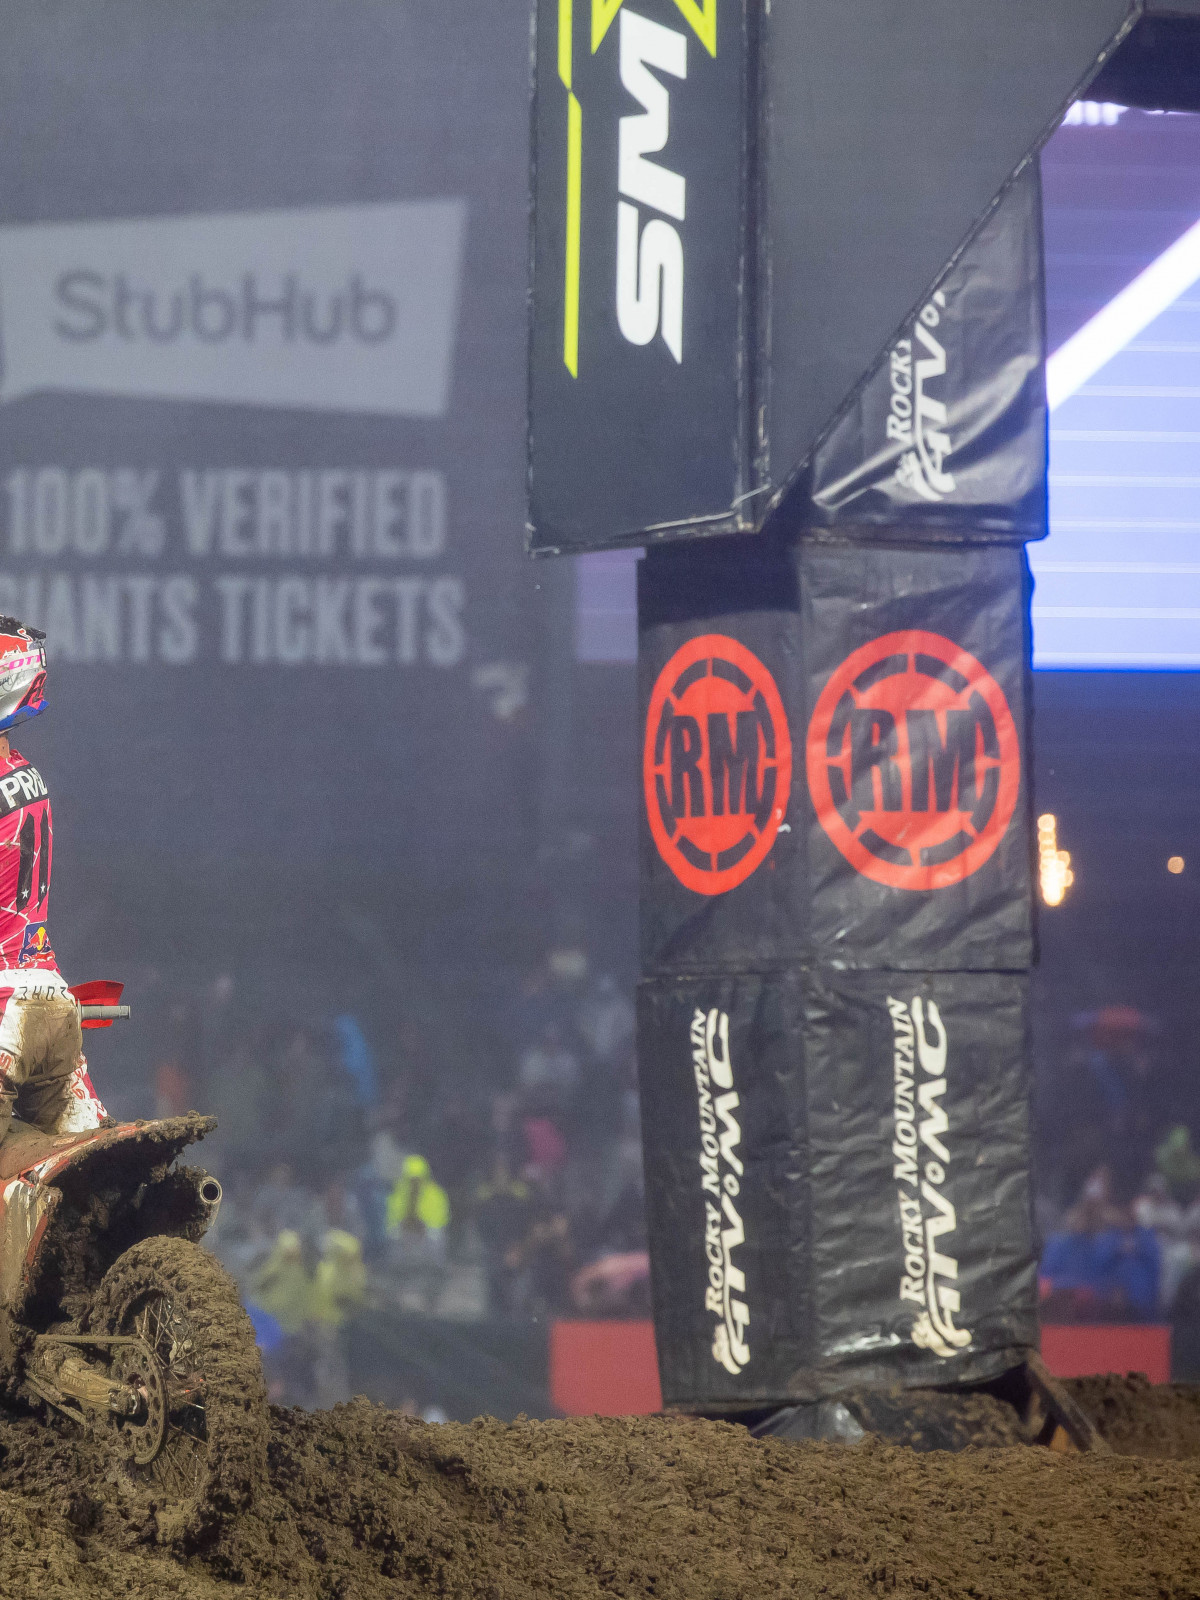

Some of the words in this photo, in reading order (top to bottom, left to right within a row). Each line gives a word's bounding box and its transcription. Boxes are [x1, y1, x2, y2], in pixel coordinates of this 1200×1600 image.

[50, 268, 396, 346] StubHub
[5, 466, 167, 557] 100%
[180, 467, 446, 559] VERIFIED
[215, 574, 467, 668] TICKETS
[668, 710, 766, 820] RM
[850, 708, 982, 814] RM
[690, 1006, 722, 1199] MOUNTAIN
[886, 994, 919, 1188] MOUNTAIN
[704, 1199, 724, 1319] ROCKY
[898, 1187, 927, 1308] ROCKY
